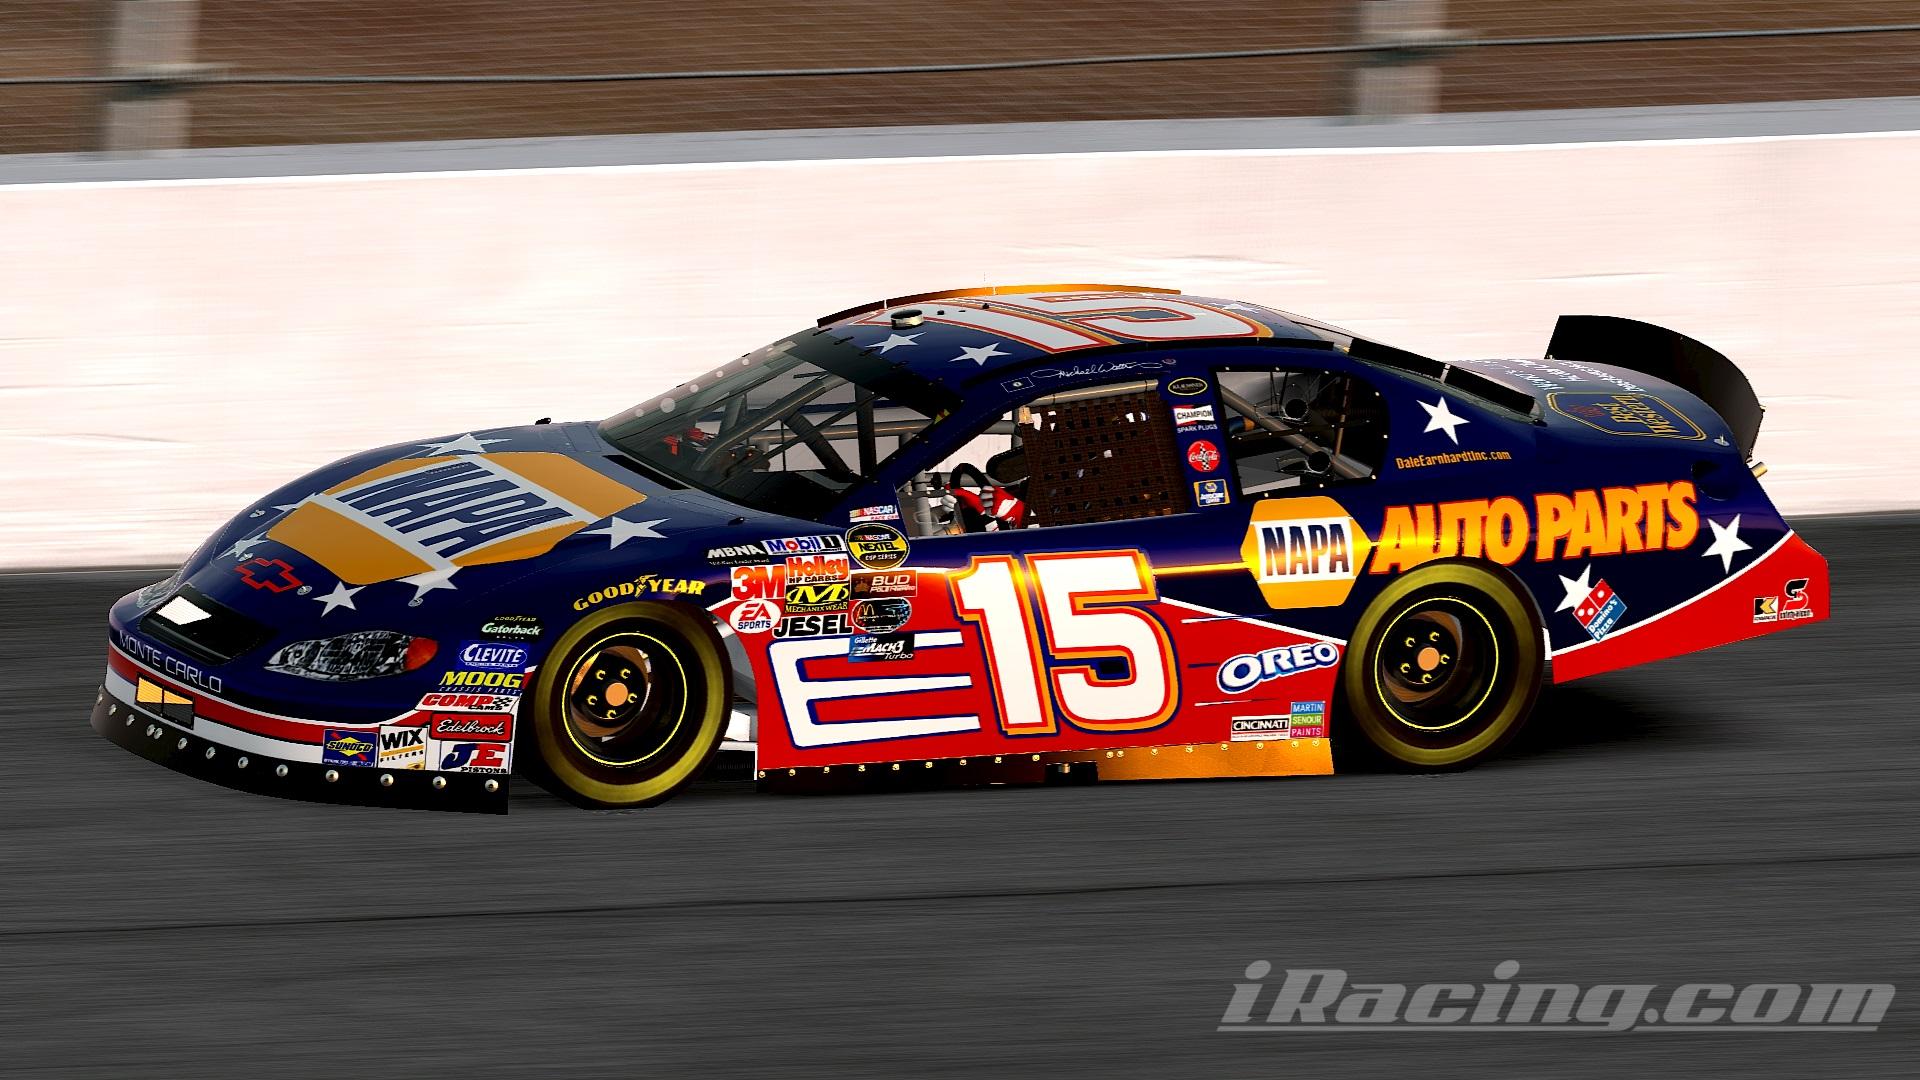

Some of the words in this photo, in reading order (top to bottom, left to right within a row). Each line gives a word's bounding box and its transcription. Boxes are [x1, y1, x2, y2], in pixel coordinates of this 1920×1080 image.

[1176, 410, 1212, 420] CHAMPION
[1395, 450, 1512, 469] DaleEarnhardtInc.com
[336, 461, 574, 558] NAPA
[863, 504, 894, 516] NASCAR
[1368, 496, 1530, 575] AUTO
[1534, 480, 1700, 562] PARTS
[707, 544, 766, 559] MBNA
[766, 536, 822, 552] Mobil
[858, 541, 898, 552] NEXTEL
[1264, 523, 1350, 576] NAPA
[787, 555, 849, 581] Holley
[732, 566, 785, 600] 3M
[871, 575, 910, 587] BUD
[785, 602, 824, 612] MECHANIX
[825, 601, 848, 610] WEAR
[1588, 599, 1618, 633] Domino's
[481, 622, 542, 635] Gatorback
[737, 619, 772, 630] SPORTS
[773, 613, 853, 638] JESEL
[1593, 617, 1614, 640] Pizza
[862, 640, 905, 653] MACH3
[948, 549, 1181, 737] 15
[463, 643, 524, 662] CLEVITE
[884, 652, 914, 660] Turbo
[120, 630, 162, 668] MONTE
[165, 655, 222, 693] CARLO
[1221, 642, 1339, 690] OREO
[438, 671, 524, 688] MOOG
[421, 694, 494, 707] COMP
[1293, 703, 1323, 713] MARTIN
[436, 719, 505, 735] Edelbrock
[1233, 719, 1288, 730] CINCINNATI
[1292, 715, 1322, 724] SENOUR
[381, 728, 423, 750] WIX
[1291, 727, 1322, 737] PAINTS
[327, 741, 374, 751] SUNOCO
[379, 750, 424, 763] FILTERS
[441, 743, 506, 770] JE
[460, 766, 507, 774] PISTONS
